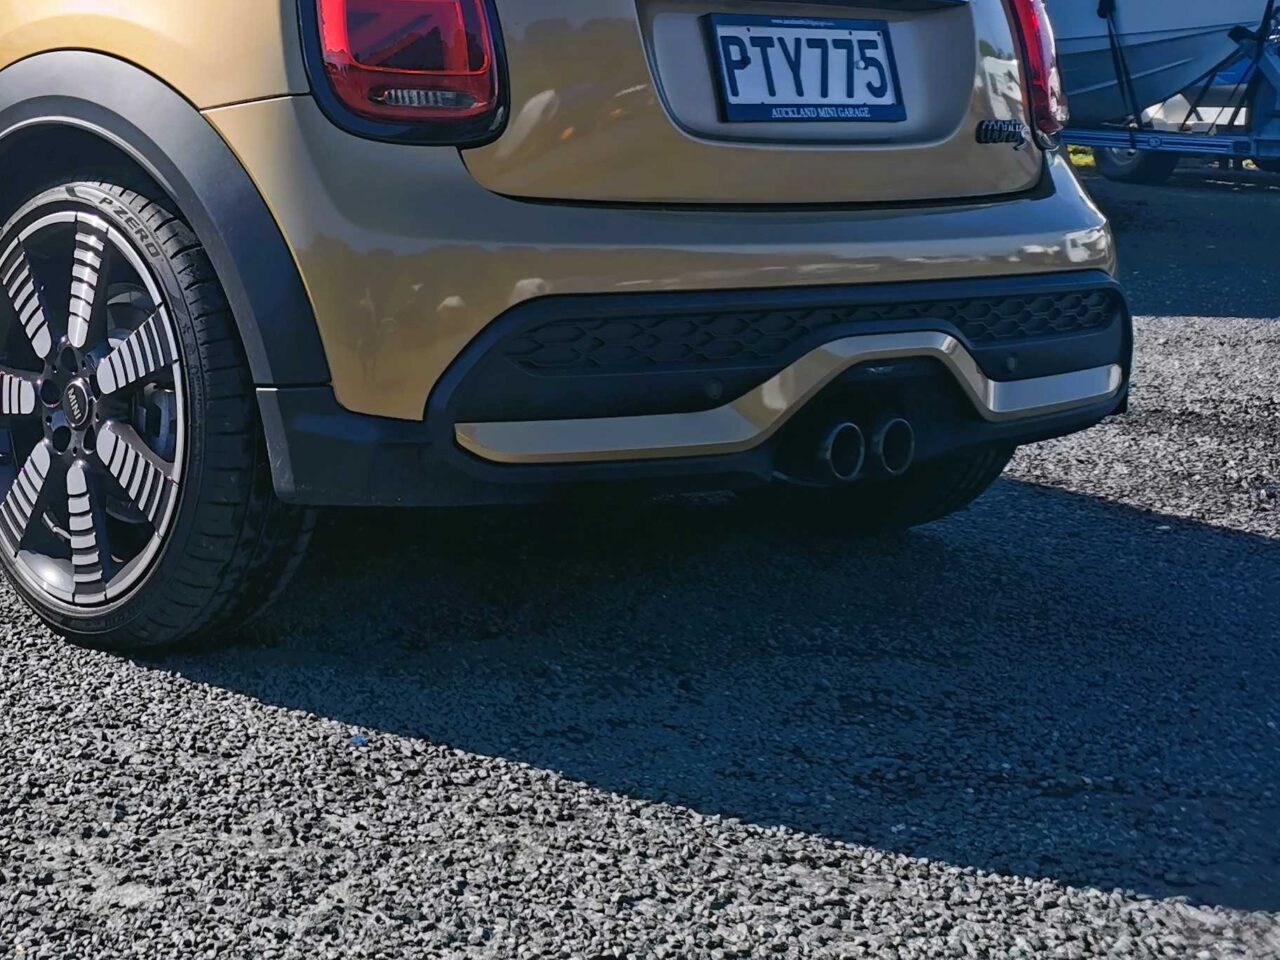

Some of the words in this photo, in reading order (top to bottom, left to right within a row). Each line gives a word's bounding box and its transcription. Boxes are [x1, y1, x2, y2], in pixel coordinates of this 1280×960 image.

[719, 35, 888, 99] PTY775
[771, 107, 817, 118] AUCKLAND
[817, 107, 837, 118] MINI
[839, 107, 871, 118] GARAGE
[113, 206, 161, 258] ZERO
[67, 387, 82, 420] MINI
